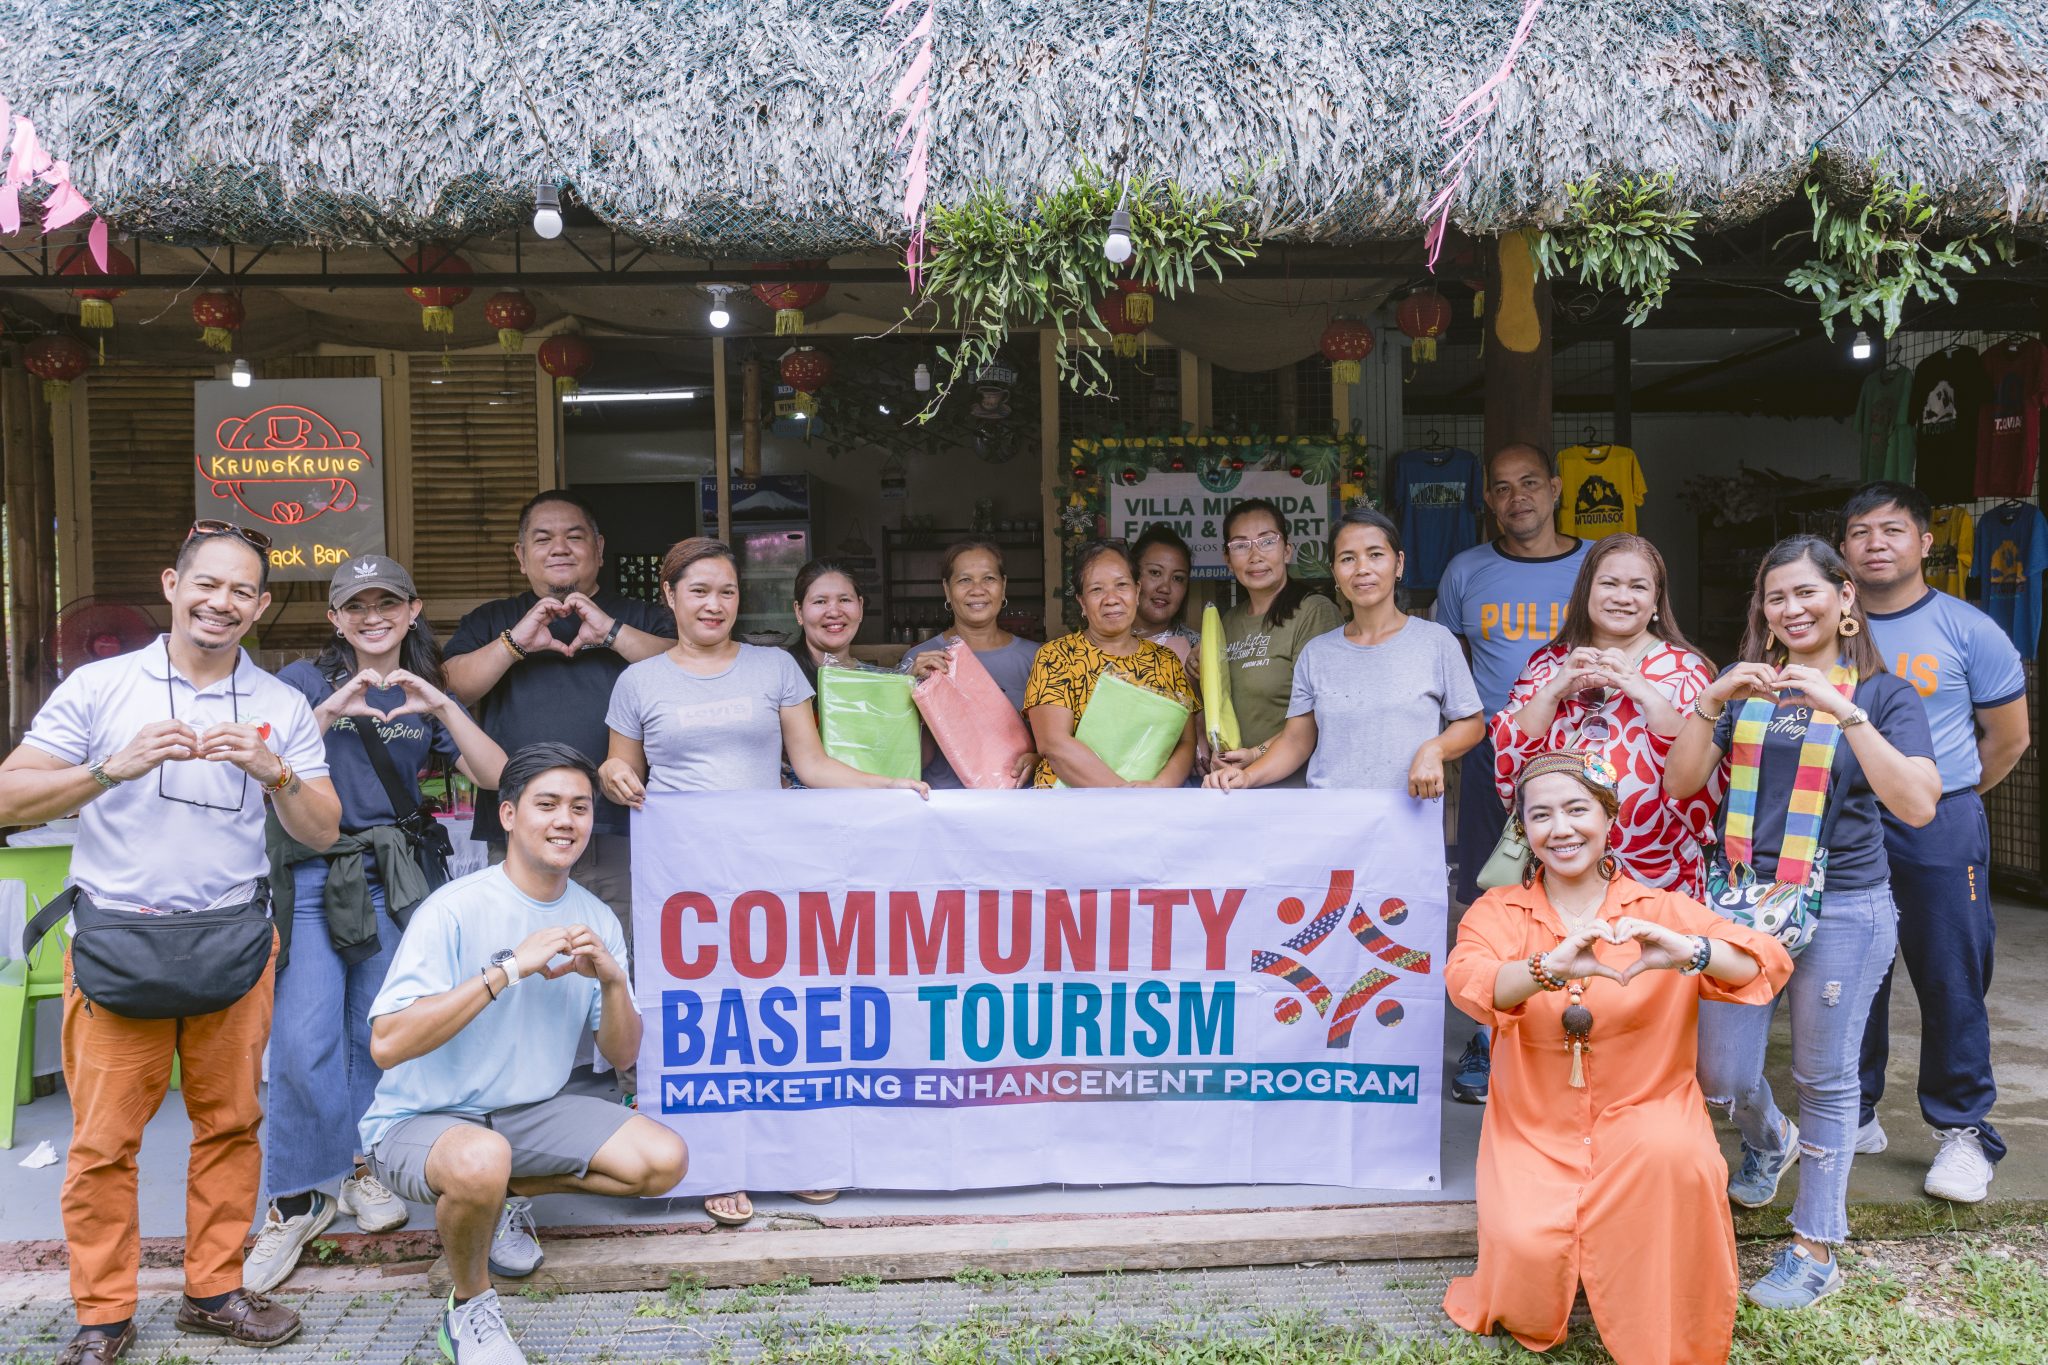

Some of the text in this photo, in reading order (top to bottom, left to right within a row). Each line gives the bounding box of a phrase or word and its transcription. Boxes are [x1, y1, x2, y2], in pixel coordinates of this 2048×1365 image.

[705, 483, 757, 491] FUENZO
[1125, 496, 1316, 516] VILLA MINDA
[1201, 520, 1218, 538] &
[269, 544, 350, 567] ack Bar
[1190, 568, 1236, 578] MABUHA
[1967, 865, 1977, 901] PULIS
[660, 889, 1248, 980] COMMUNITY
[661, 980, 1236, 1067] BASED TOURISM
[665, 1068, 1416, 1107] MARKETING ENHANCEMENT PROGRAM
